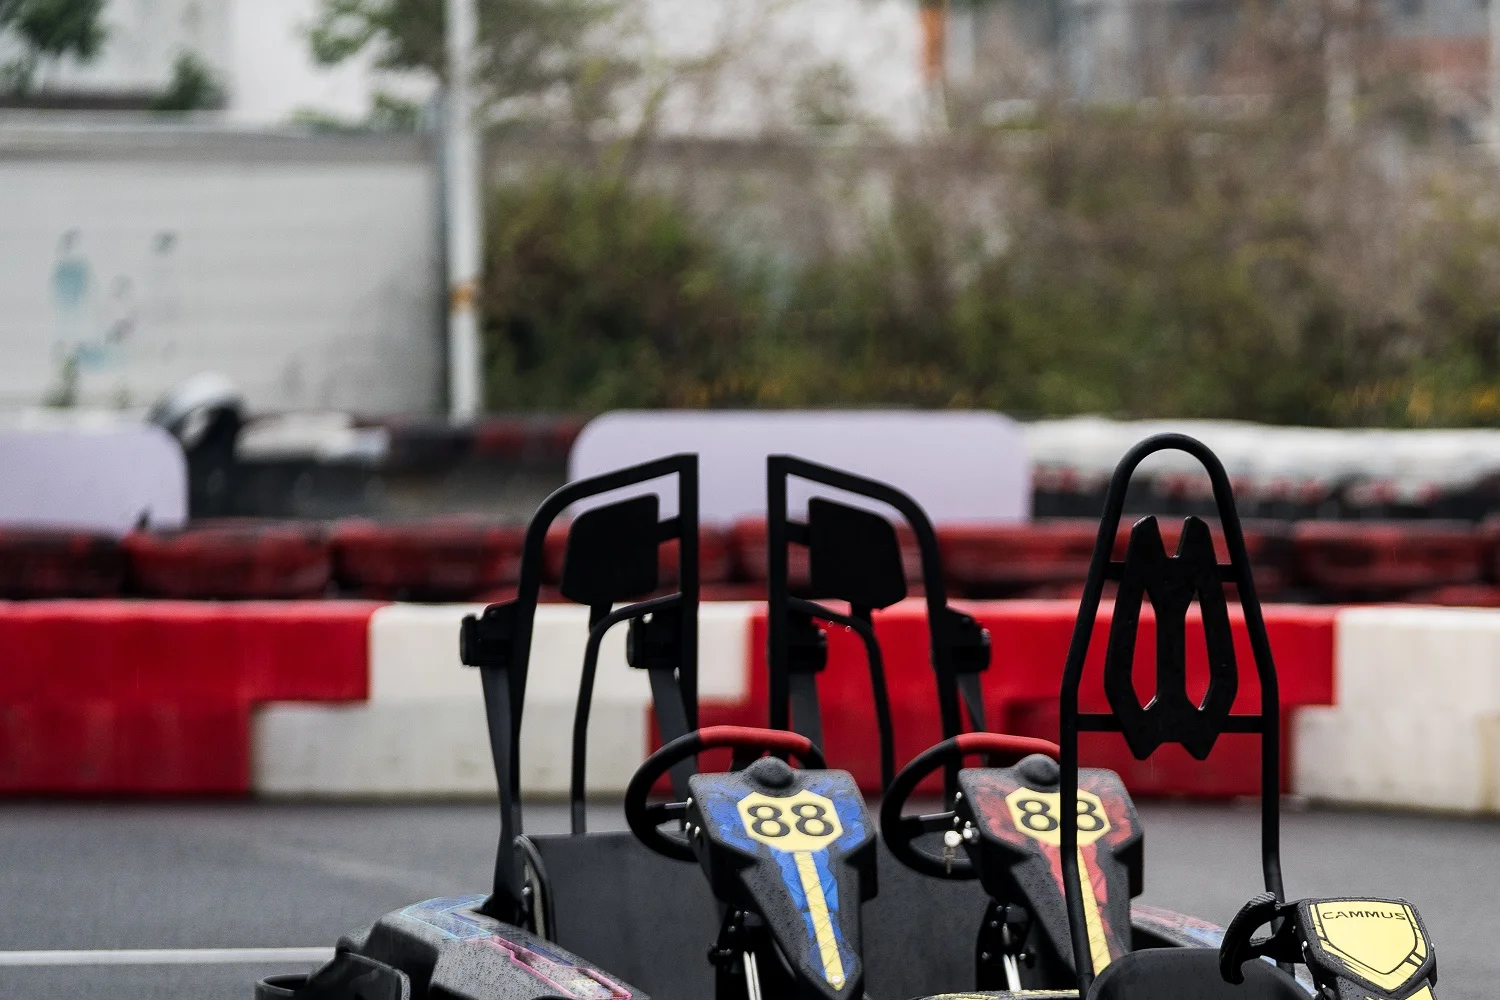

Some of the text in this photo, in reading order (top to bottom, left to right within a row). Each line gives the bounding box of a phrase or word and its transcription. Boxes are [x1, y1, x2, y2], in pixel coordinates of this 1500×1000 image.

[747, 803, 835, 837] 88
[1016, 799, 1105, 832] 88
[1322, 910, 1407, 921] CAMMUS
